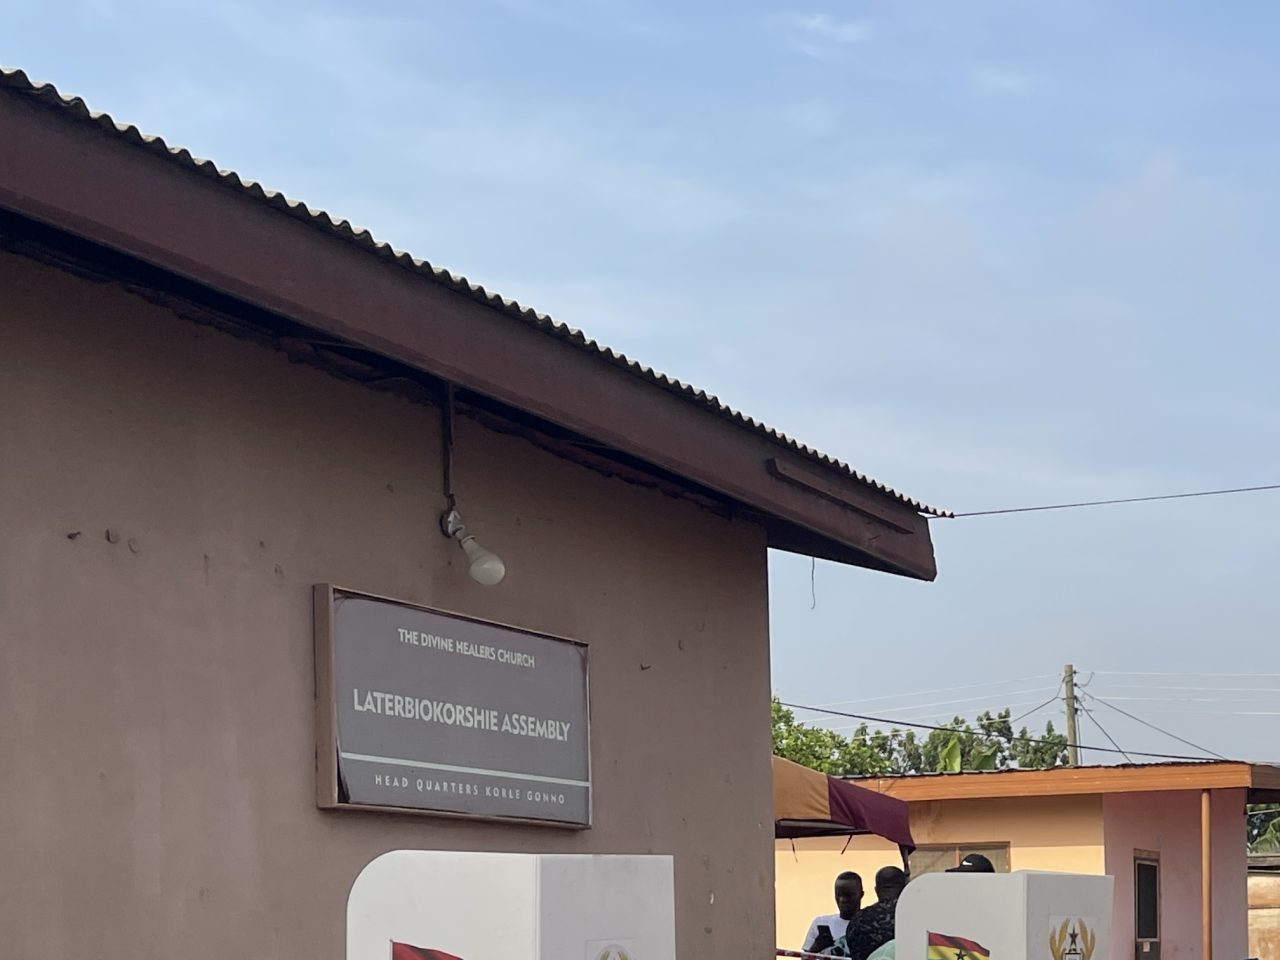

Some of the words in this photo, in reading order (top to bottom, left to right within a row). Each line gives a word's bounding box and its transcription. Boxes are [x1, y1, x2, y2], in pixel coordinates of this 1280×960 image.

[398, 628, 418, 645] THE
[421, 633, 453, 652] DIVINE
[456, 641, 495, 661] HEALERS
[497, 649, 535, 668] CHURCH
[353, 688, 498, 731] LATERBIOKORSHIE
[501, 714, 571, 742] ASSEMBLY
[375, 774, 408, 788] HEAD
[416, 778, 478, 796] QUARTERS
[485, 786, 521, 800] KORLE
[527, 790, 565, 804] GONNO
